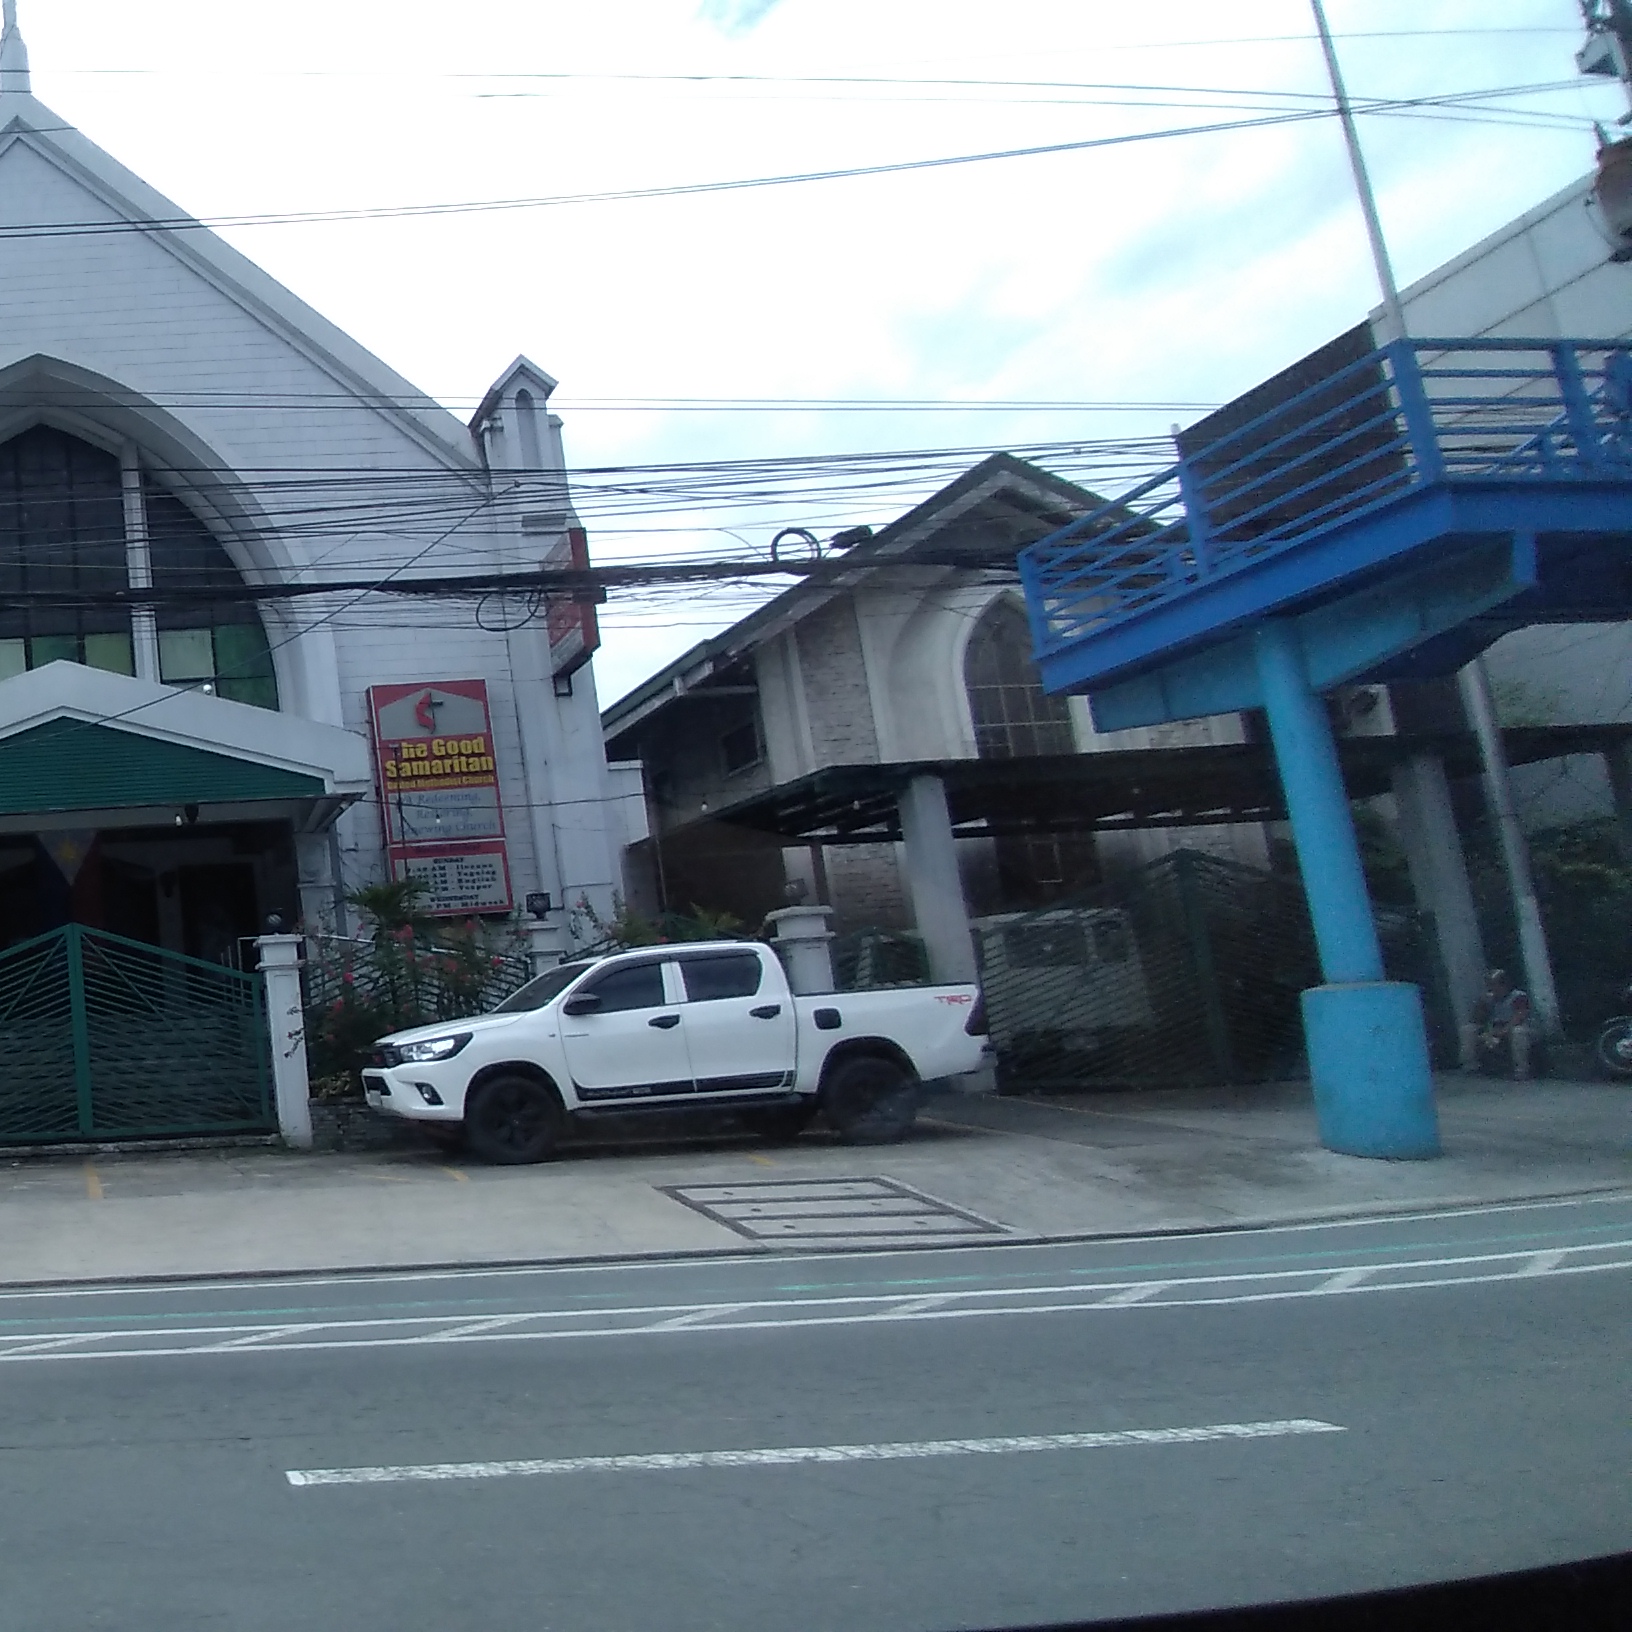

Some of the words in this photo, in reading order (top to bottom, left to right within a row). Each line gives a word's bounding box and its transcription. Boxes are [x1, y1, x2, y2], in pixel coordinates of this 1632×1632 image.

[432, 736, 485, 757] Good
[385, 755, 494, 778] Samaritan
[933, 994, 972, 1006] TRD
